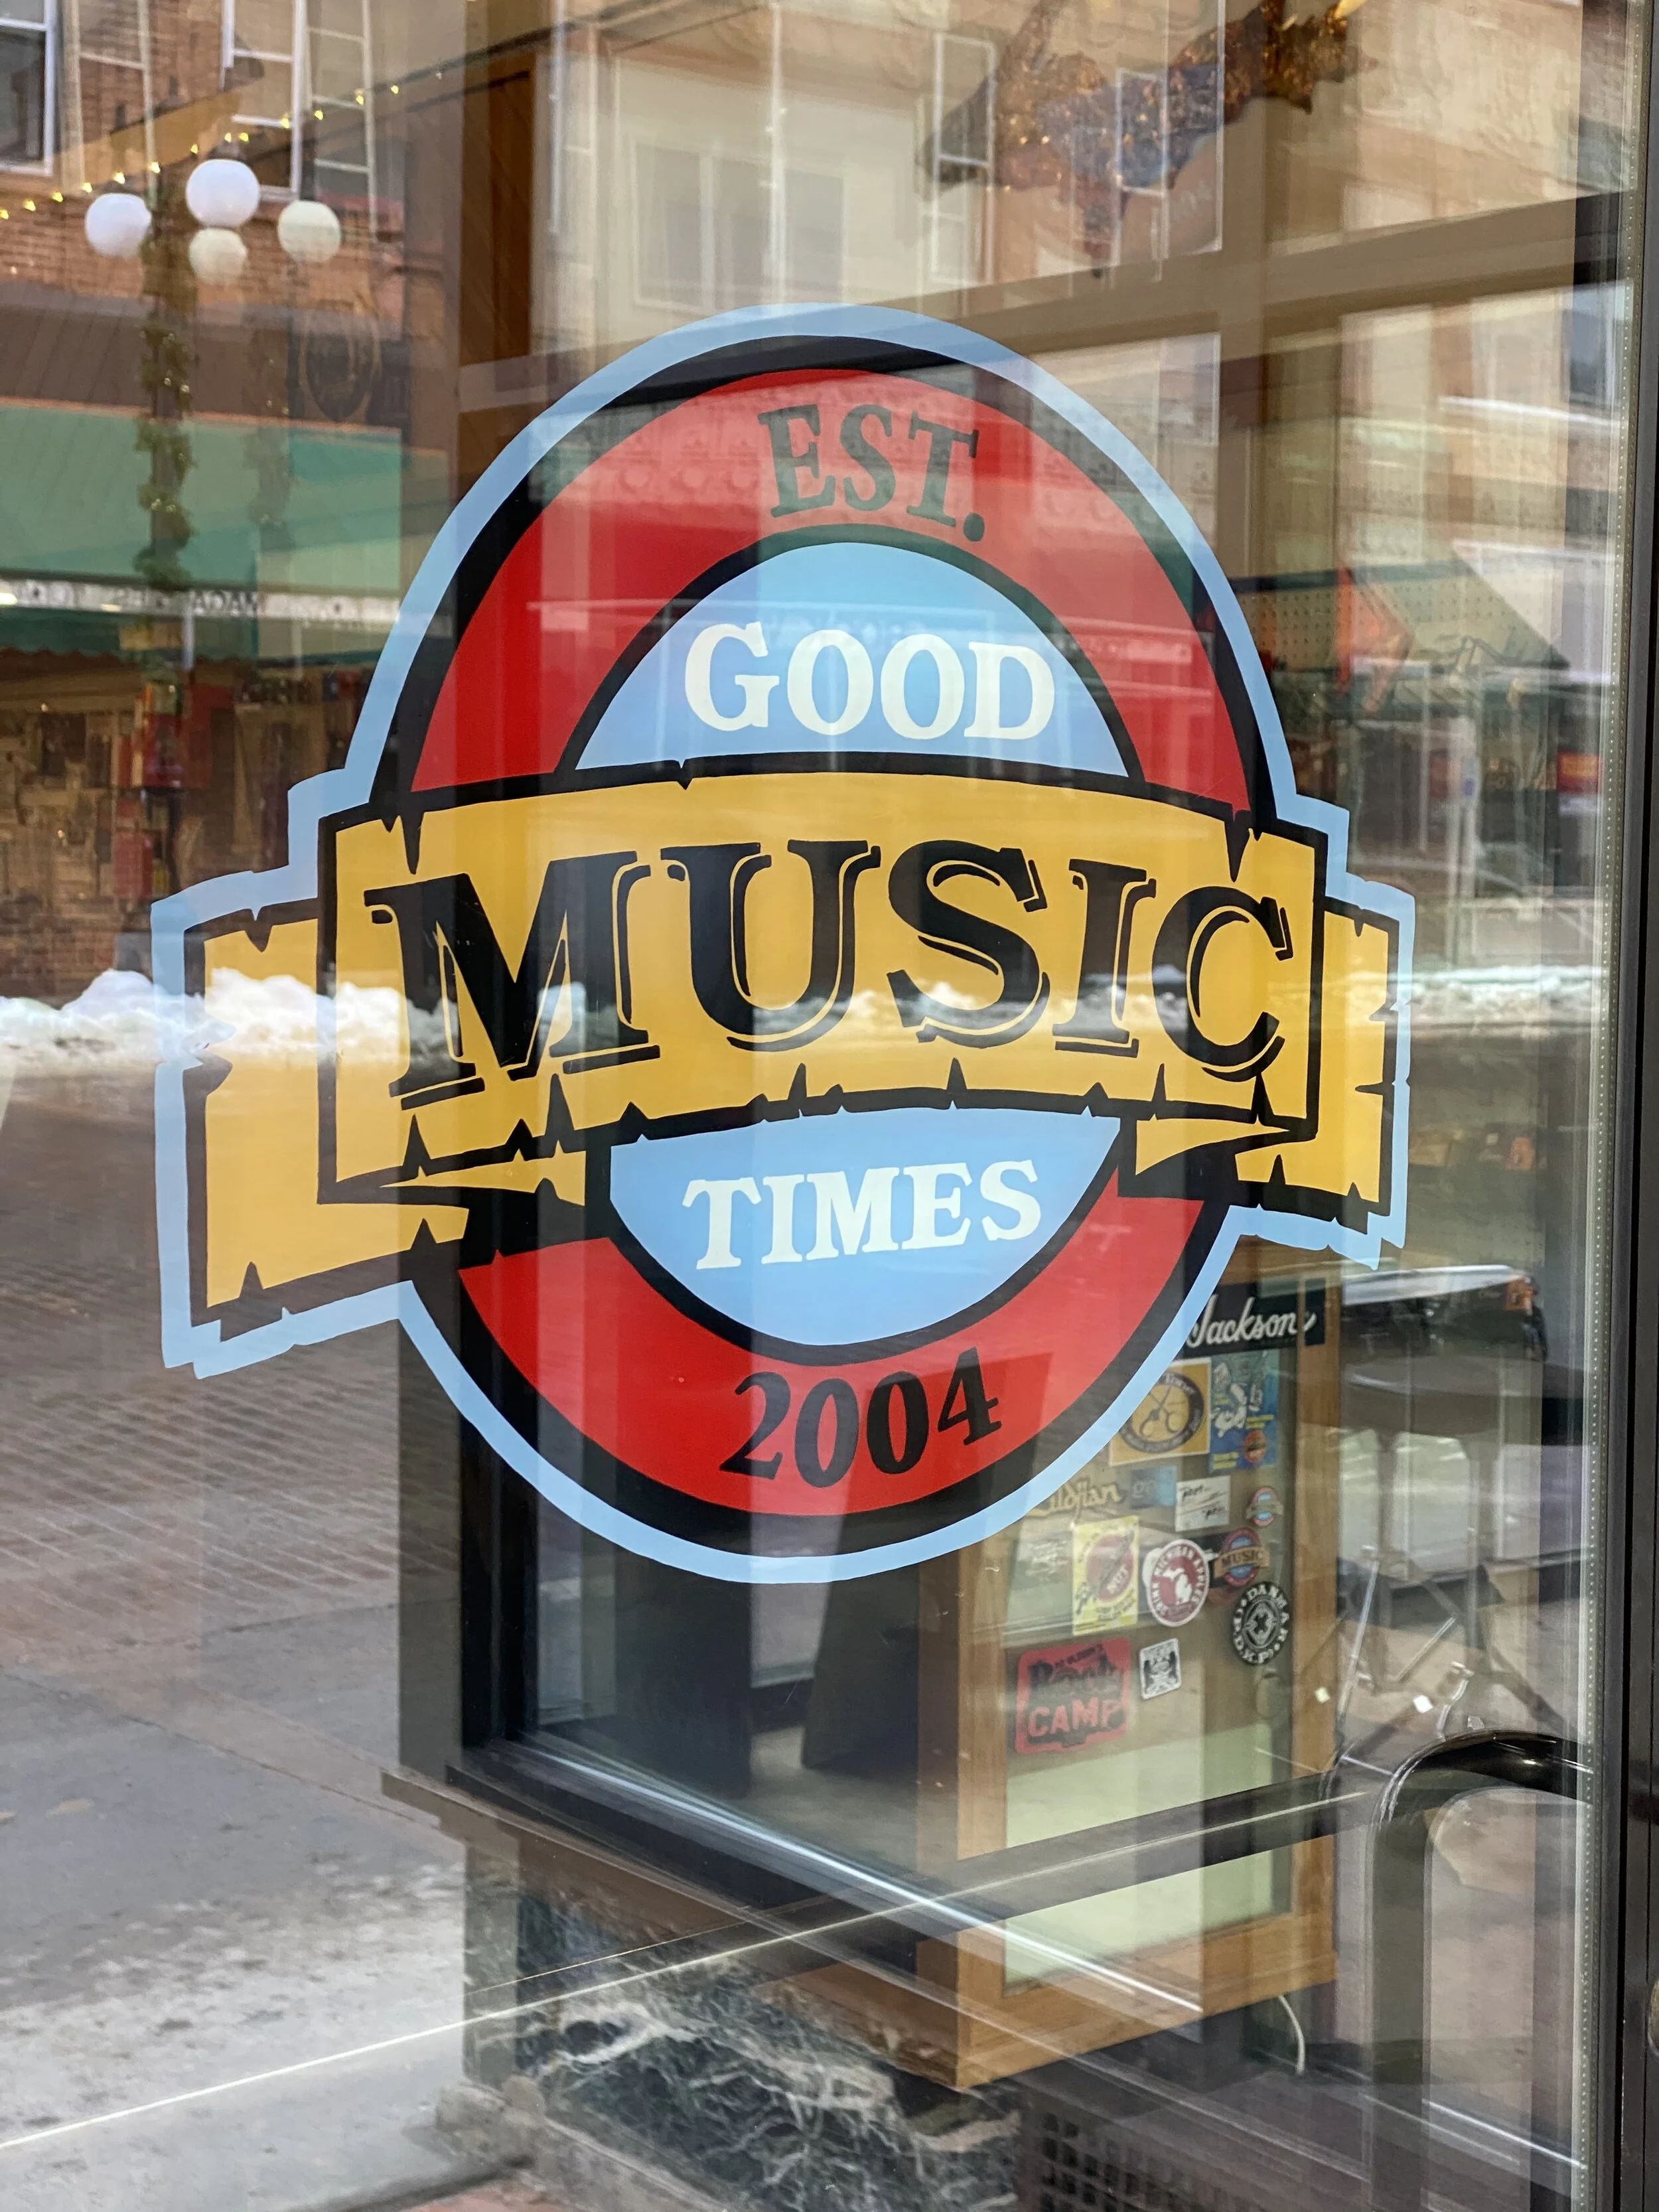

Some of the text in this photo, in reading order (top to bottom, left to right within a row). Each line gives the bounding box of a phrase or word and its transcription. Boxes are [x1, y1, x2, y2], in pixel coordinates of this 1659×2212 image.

[758, 404, 985, 542] EST.
[685, 621, 1055, 740] GOOD
[365, 840, 1295, 1110] MUSIC
[682, 1159, 1041, 1270] TIMES
[1187, 1293, 1317, 1348] Jackson
[719, 1347, 1002, 1487] 2004
[1027, 1477, 1123, 1524] ildjian
[1029, 1696, 1122, 1737] CAMP
